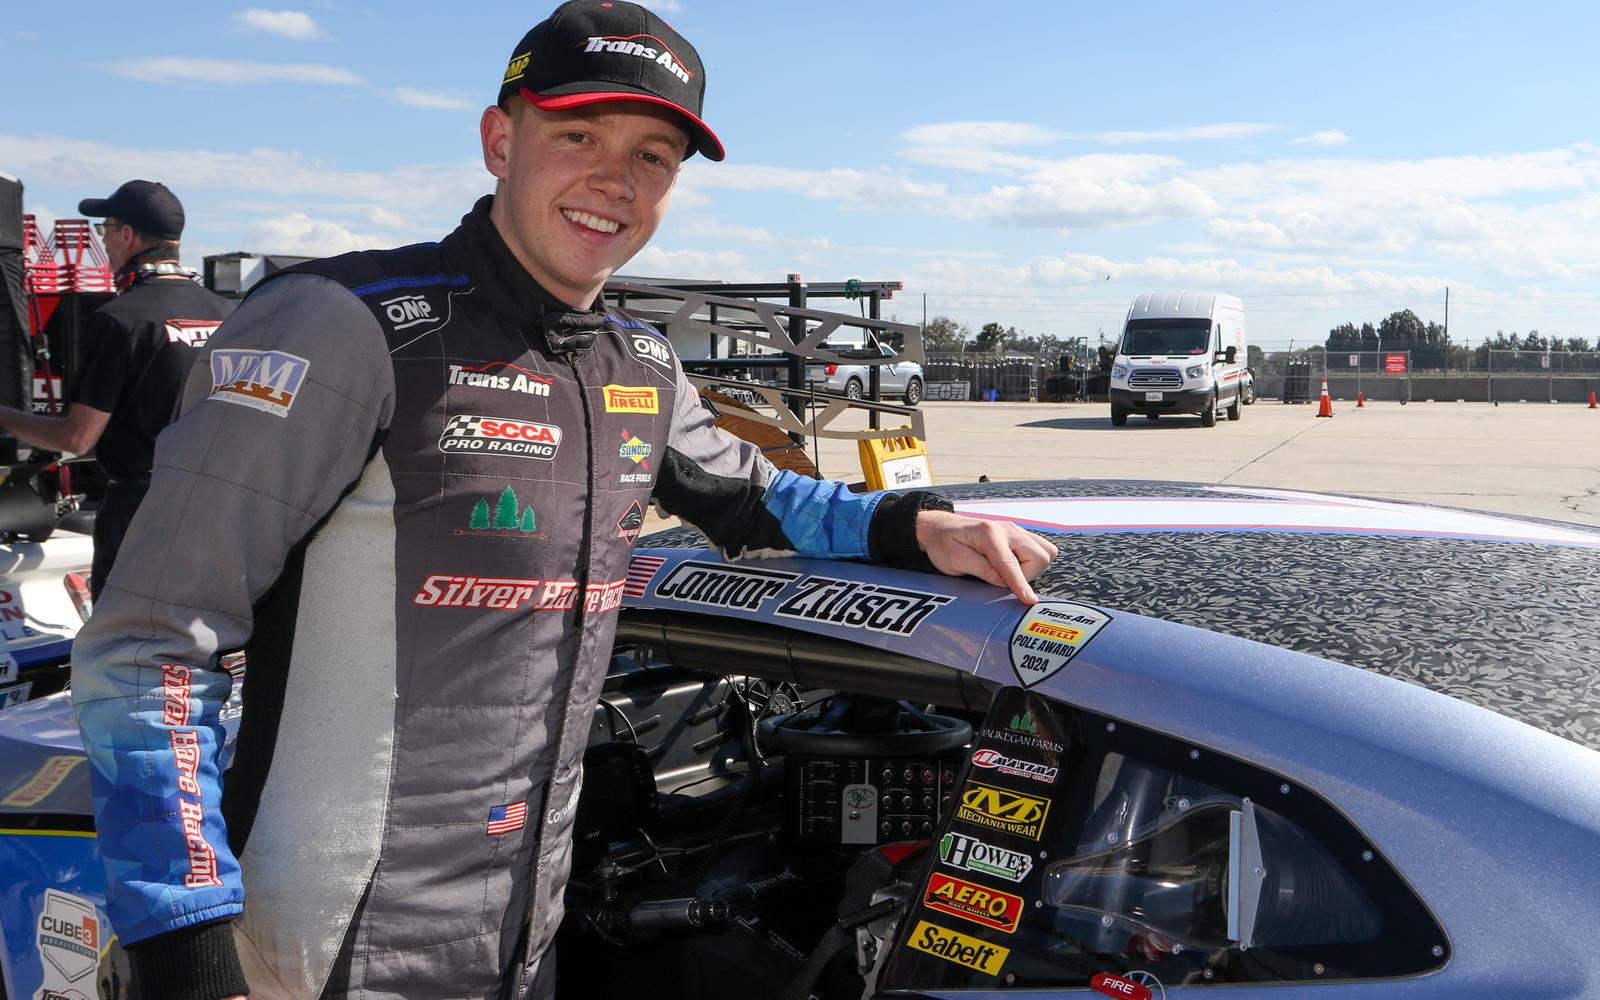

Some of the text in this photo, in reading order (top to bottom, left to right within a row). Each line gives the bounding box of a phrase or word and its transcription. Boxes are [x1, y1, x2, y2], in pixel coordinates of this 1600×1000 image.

[584, 37, 691, 84] Trans Am
[633, 338, 671, 363] OMP
[449, 365, 550, 397] Trans Am
[608, 388, 655, 409] PIRELLI
[480, 420, 556, 444] SCCA
[443, 439, 553, 456] PRO RACING
[620, 445, 651, 457] SUNOCO
[620, 474, 652, 483] RACE FUELS
[895, 469, 921, 484] Trans Am
[414, 573, 540, 610] Silver
[656, 560, 955, 636] Connor Zilisch
[1038, 608, 1073, 621] Trans
[1070, 614, 1097, 626] Am
[1028, 622, 1078, 641] PIRELLI
[1013, 634, 1076, 657] POLE AWARD
[1020, 654, 1050, 673] 2024
[169, 729, 203, 798] Hare
[957, 806, 1037, 838] MECHANIX WEAR
[179, 798, 225, 889] Racing
[934, 881, 1008, 917] AERO
[918, 926, 995, 970] Sabelt
[1102, 977, 1135, 995] FIRE
